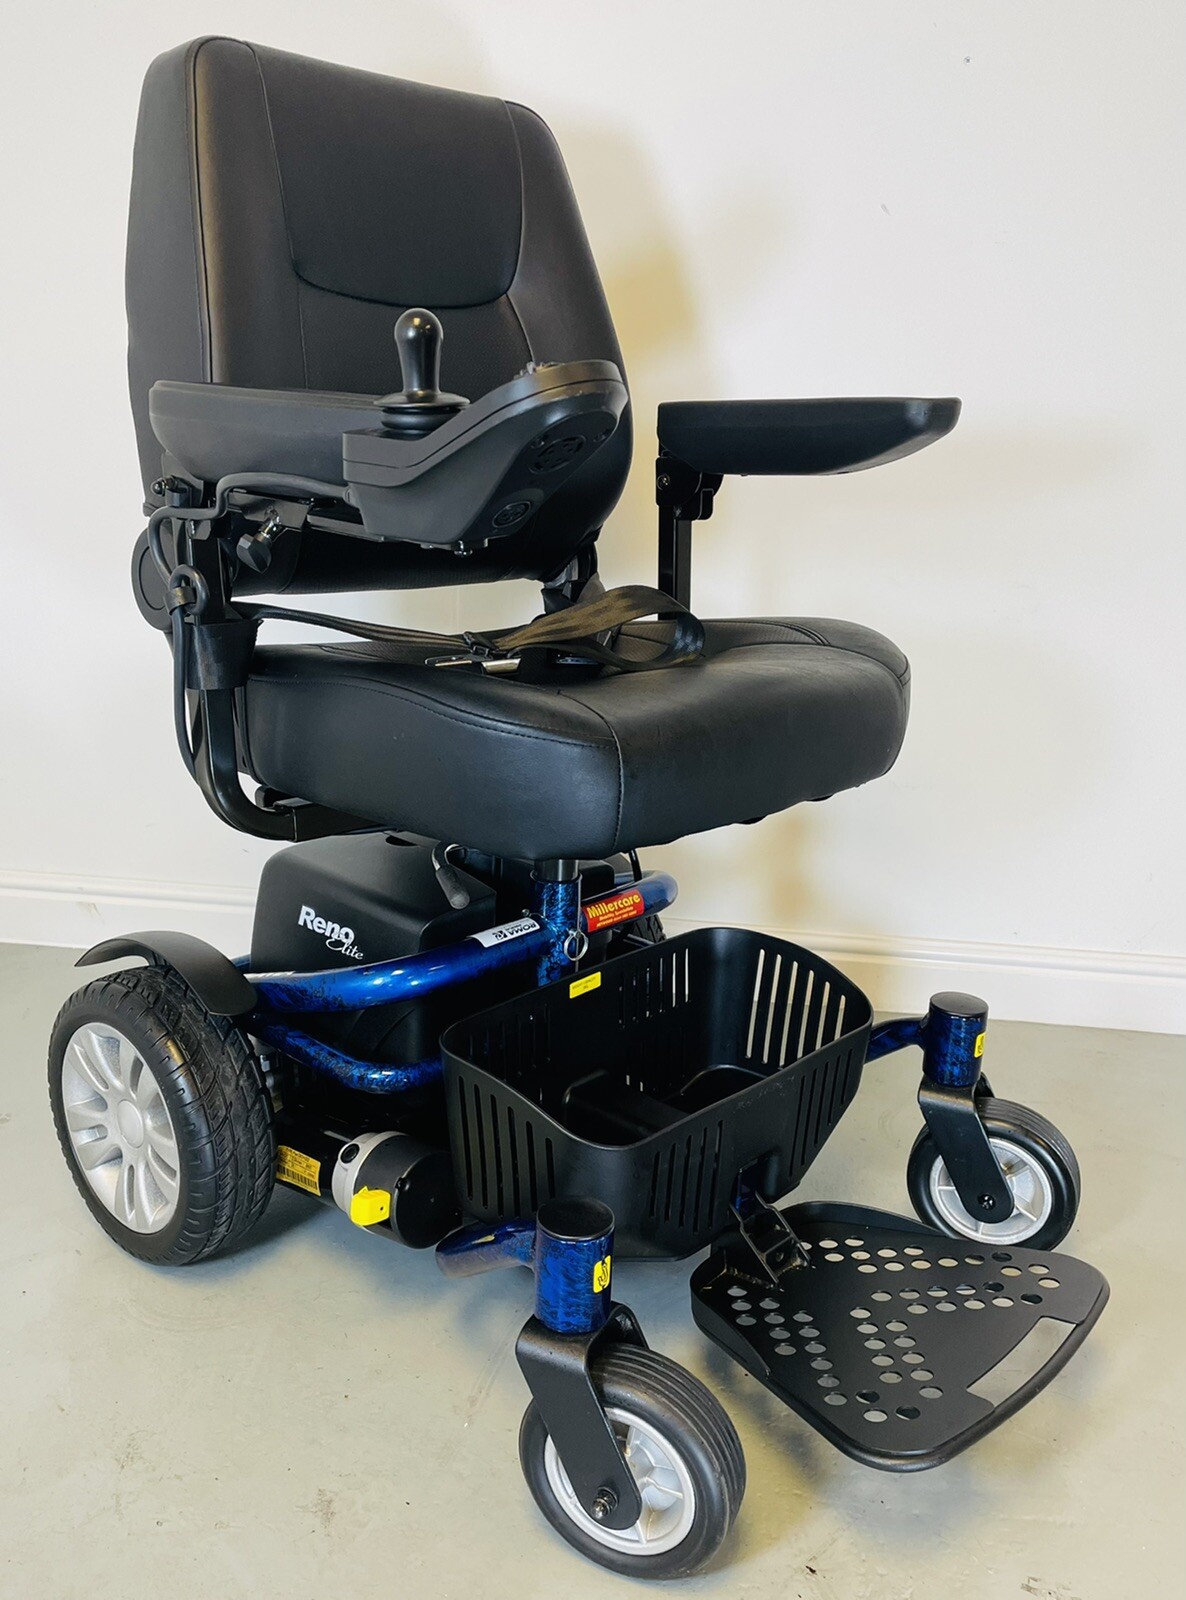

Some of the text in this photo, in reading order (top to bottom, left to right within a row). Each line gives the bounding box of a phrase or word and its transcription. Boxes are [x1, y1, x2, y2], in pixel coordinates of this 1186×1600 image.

[587, 895, 640, 918] Millercare
[298, 905, 354, 943] Reno
[508, 922, 536, 935] ROMA
[326, 932, 363, 959] Elite
